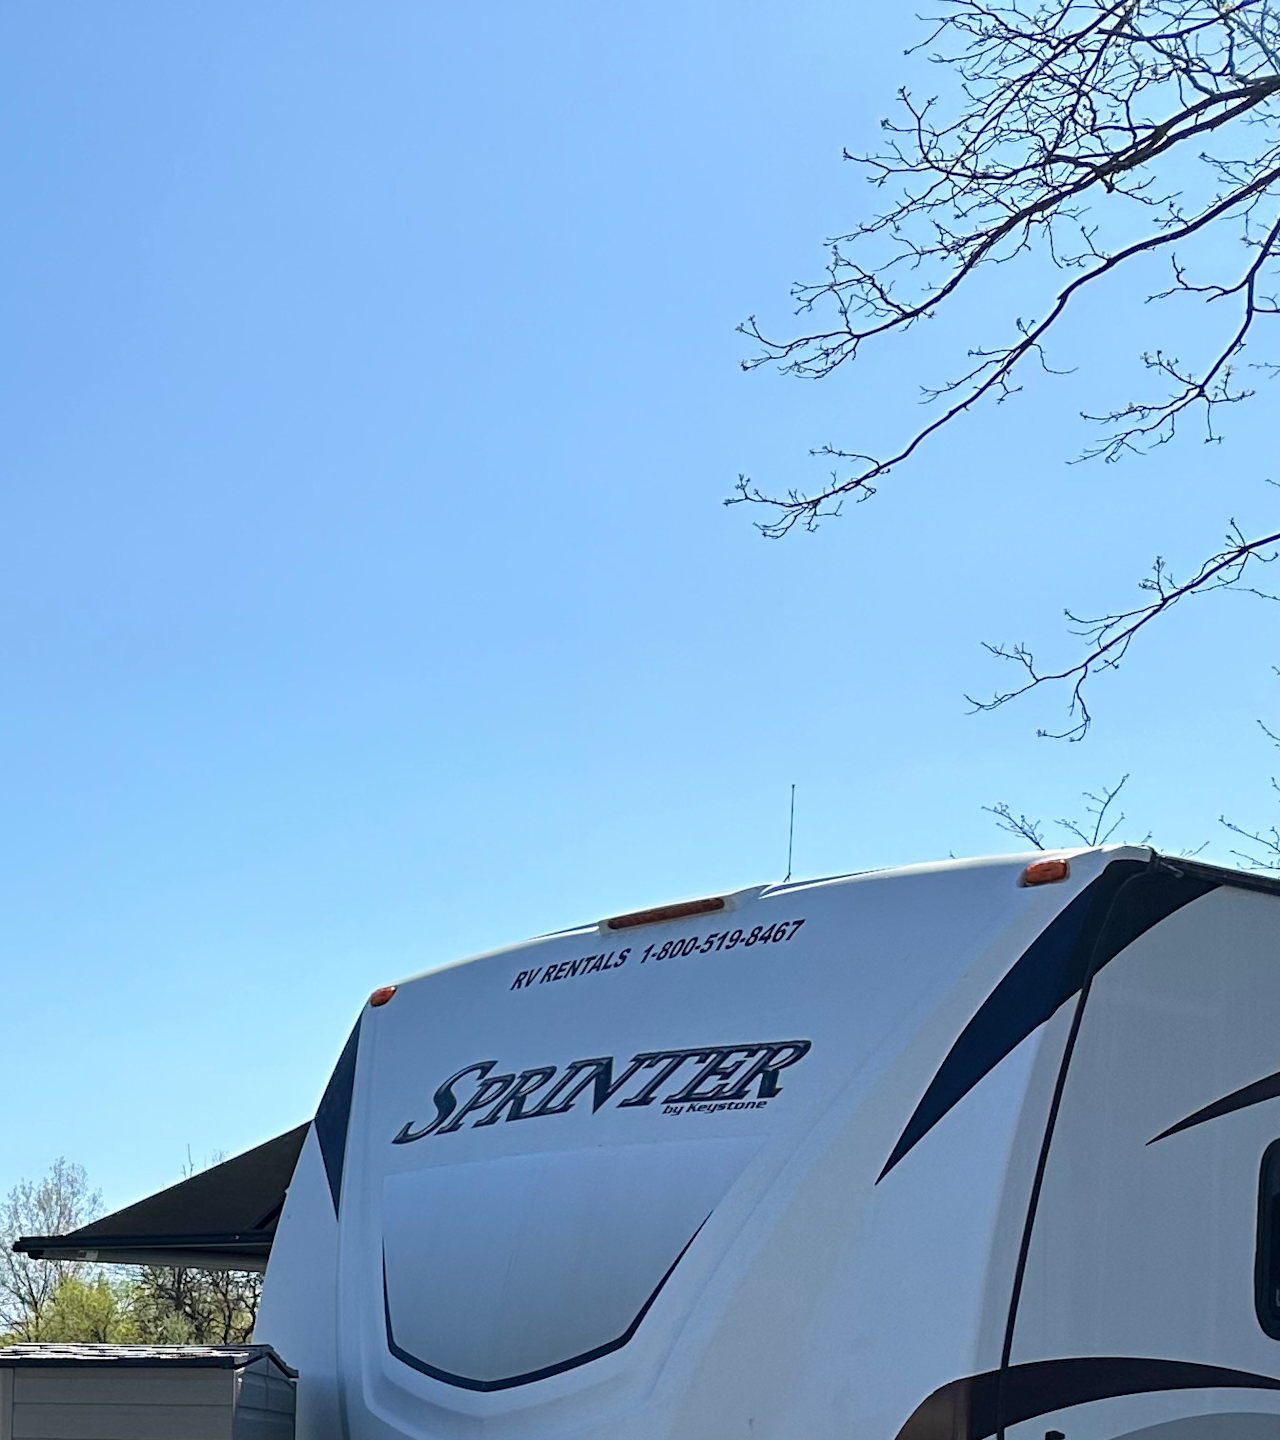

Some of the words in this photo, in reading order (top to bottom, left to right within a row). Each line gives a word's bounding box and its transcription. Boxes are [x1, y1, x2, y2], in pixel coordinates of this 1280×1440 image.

[509, 967, 542, 991] RV
[539, 948, 632, 985] RENTALS
[639, 918, 807, 965] 1-800-519-8467
[390, 1039, 812, 1145] SPRINTER
[662, 1104, 684, 1117] by
[685, 1099, 768, 1117] Keystone
